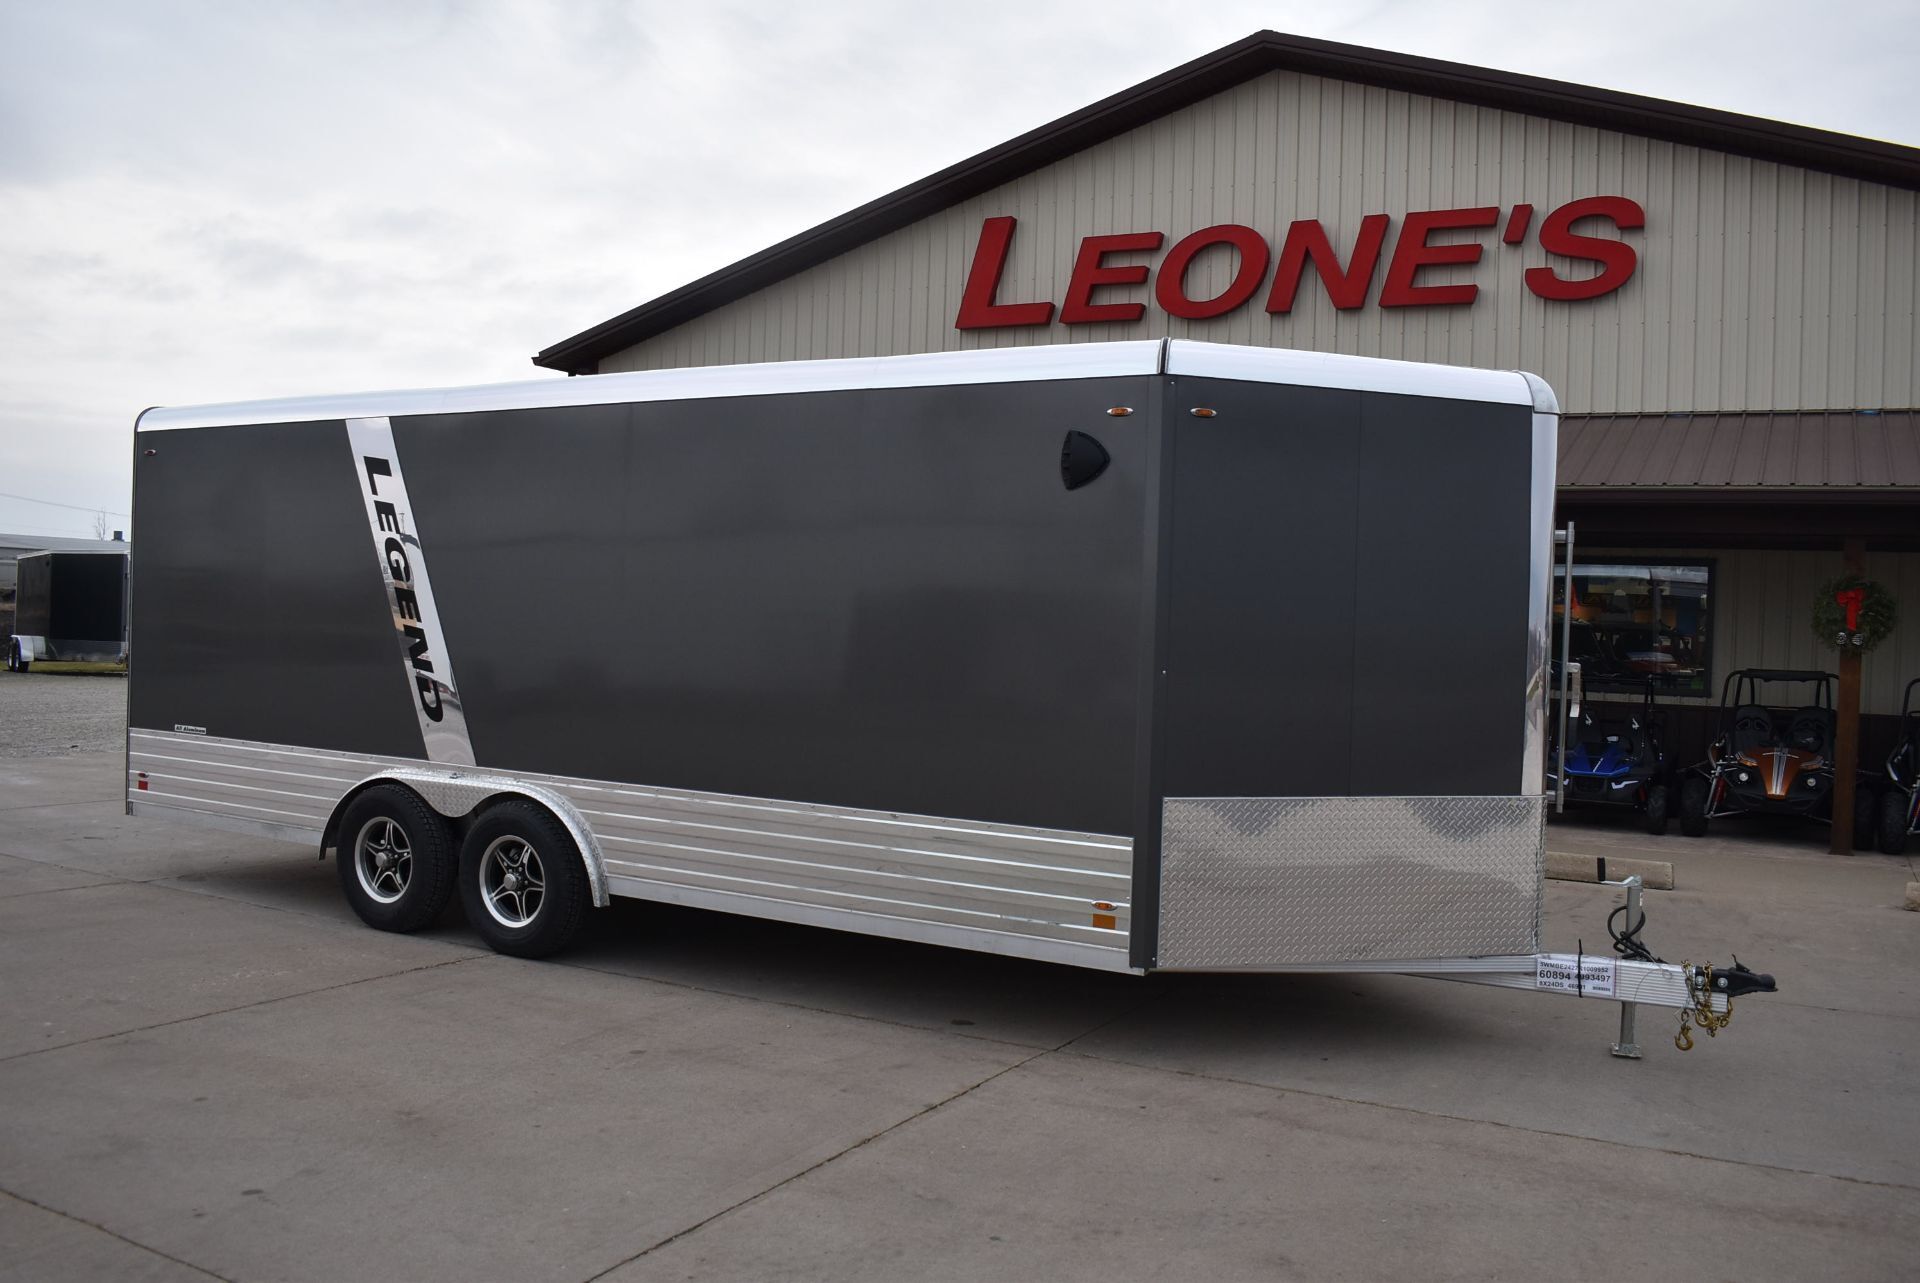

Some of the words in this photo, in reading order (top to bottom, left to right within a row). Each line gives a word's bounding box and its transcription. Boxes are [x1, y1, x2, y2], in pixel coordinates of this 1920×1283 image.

[955, 195, 1645, 329] LEONE'S
[363, 455, 444, 723] LEGEND
[1539, 970, 1571, 980] 60894
